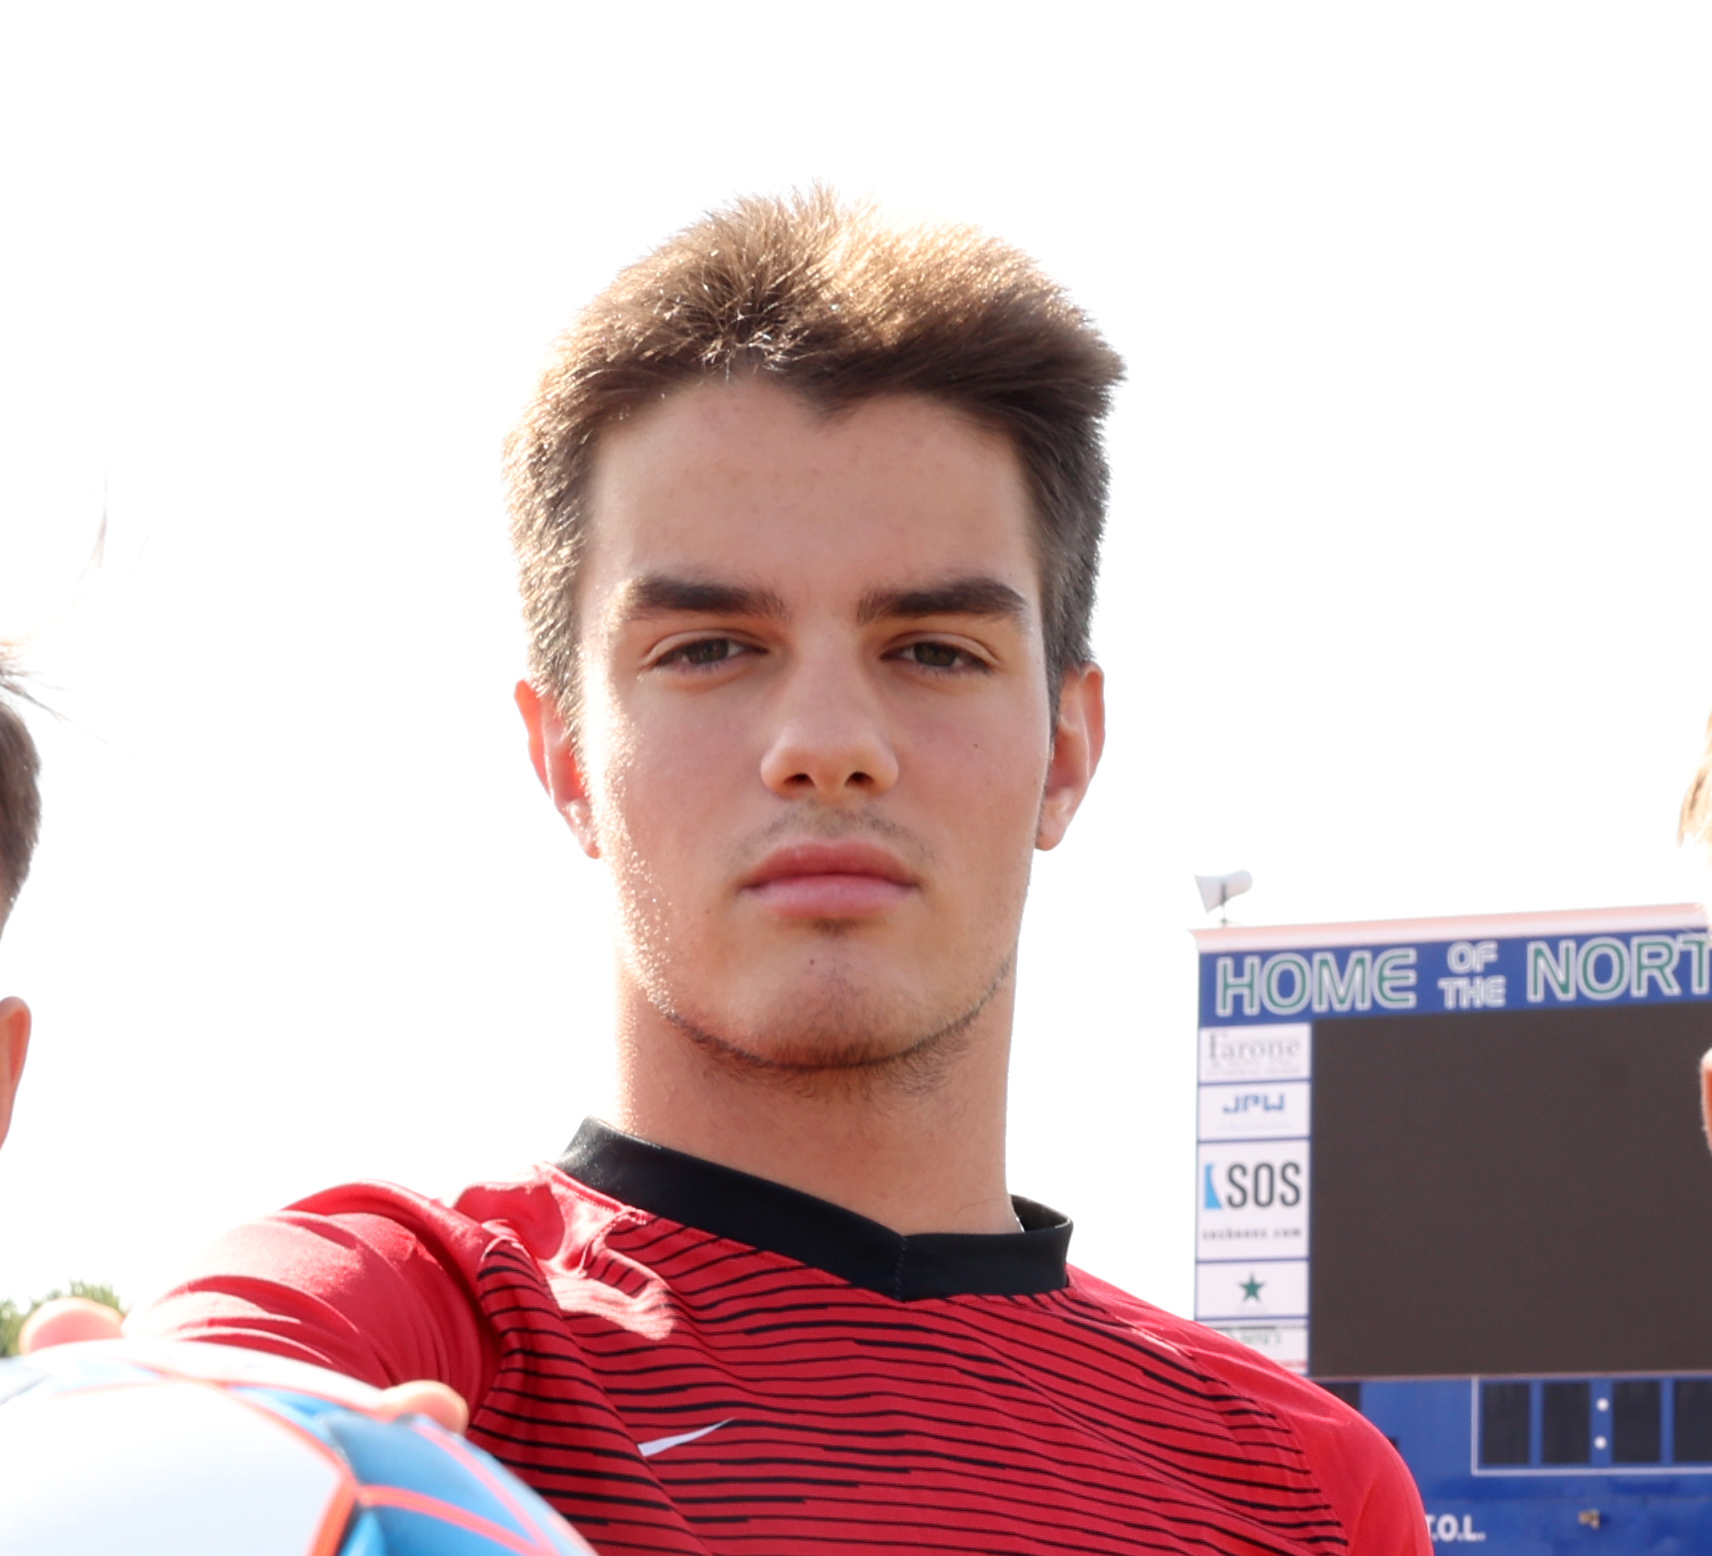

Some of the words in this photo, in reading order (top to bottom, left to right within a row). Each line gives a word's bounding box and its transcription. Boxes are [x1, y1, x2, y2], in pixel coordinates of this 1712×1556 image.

[1447, 941, 1498, 974] OF
[1216, 947, 1417, 1017] HOME
[1437, 975, 1506, 1010] THE
[1223, 1094, 1285, 1112] JPW
[1227, 1162, 1300, 1208] SOS
